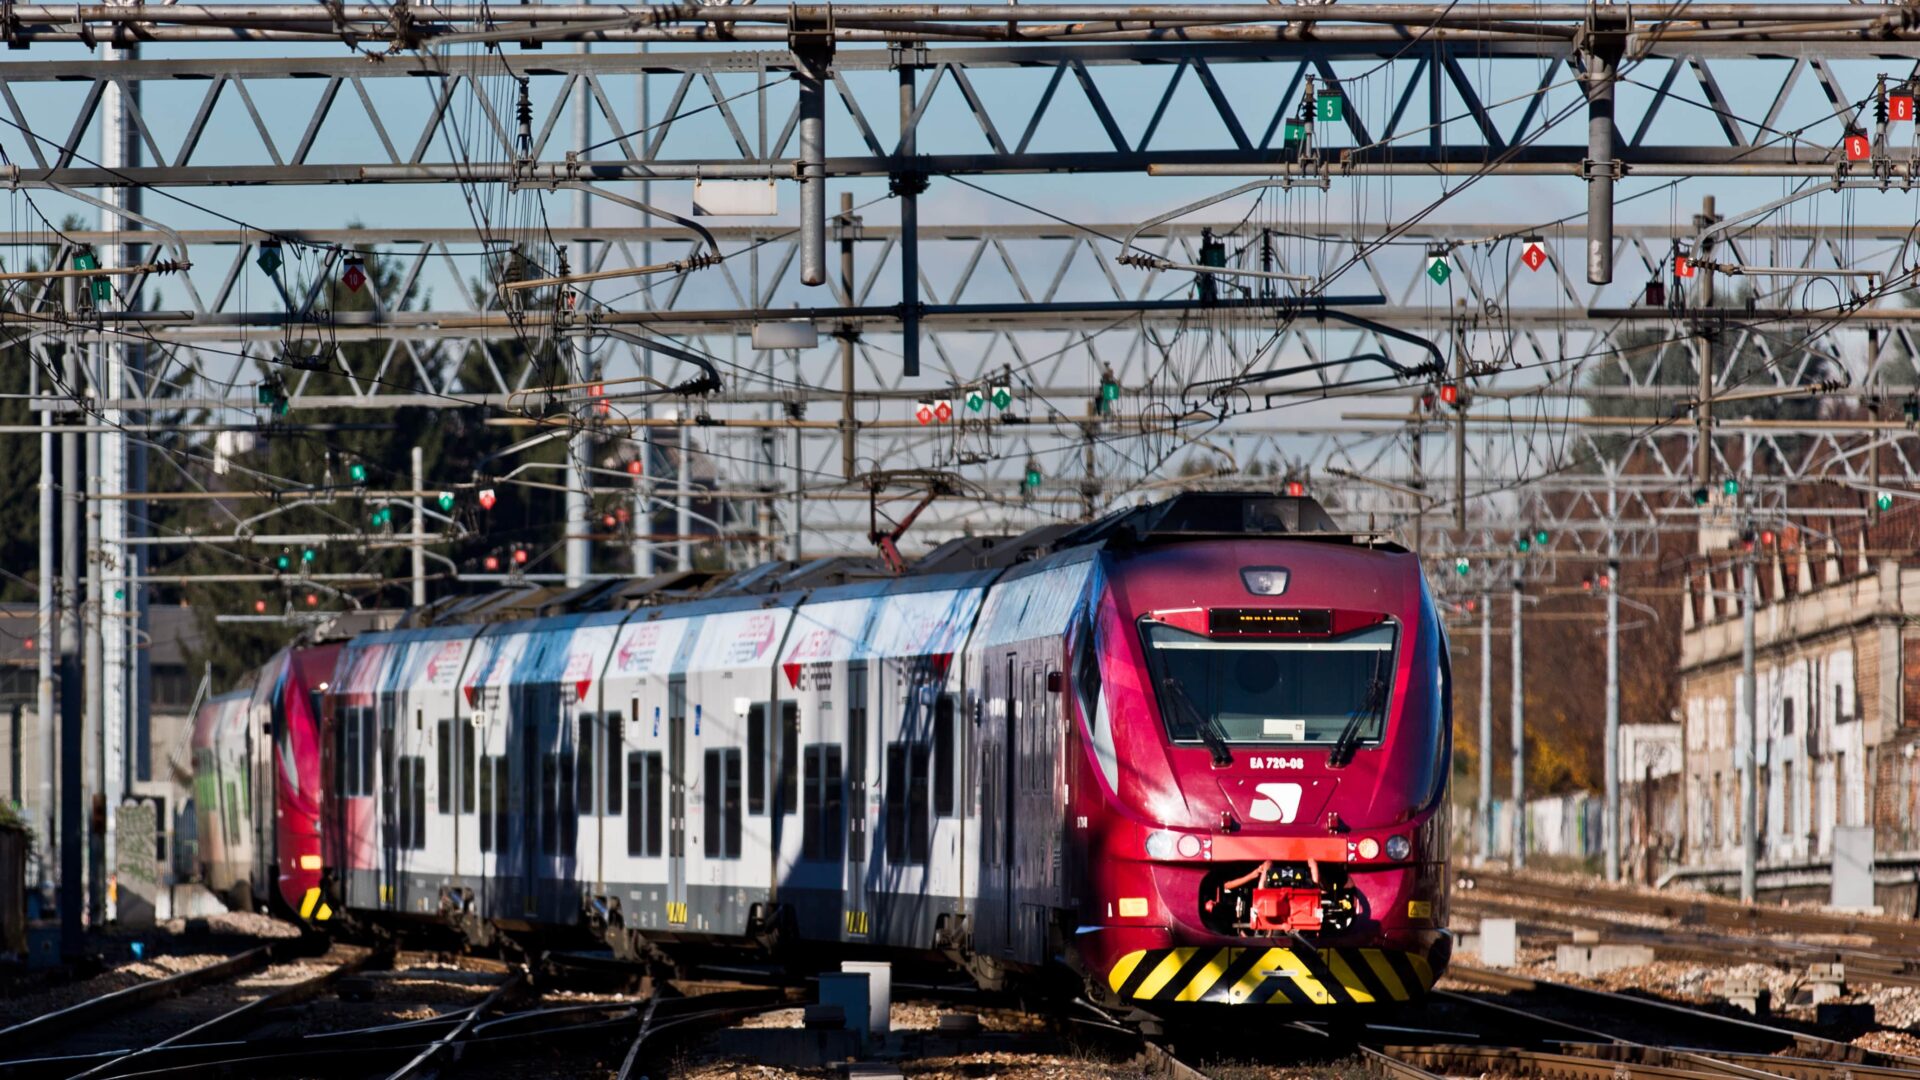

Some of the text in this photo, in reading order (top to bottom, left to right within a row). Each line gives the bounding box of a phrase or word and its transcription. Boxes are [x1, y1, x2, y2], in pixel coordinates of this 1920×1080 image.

[1327, 100, 1333, 117] 5
[1898, 100, 1904, 117] 6
[1853, 139, 1862, 156] 6
[1531, 251, 1538, 266] 6
[1437, 265, 1443, 277] 5
[1682, 262, 1688, 275] 6
[349, 273, 358, 286] 10
[1250, 757, 1304, 770] EA 720-08
